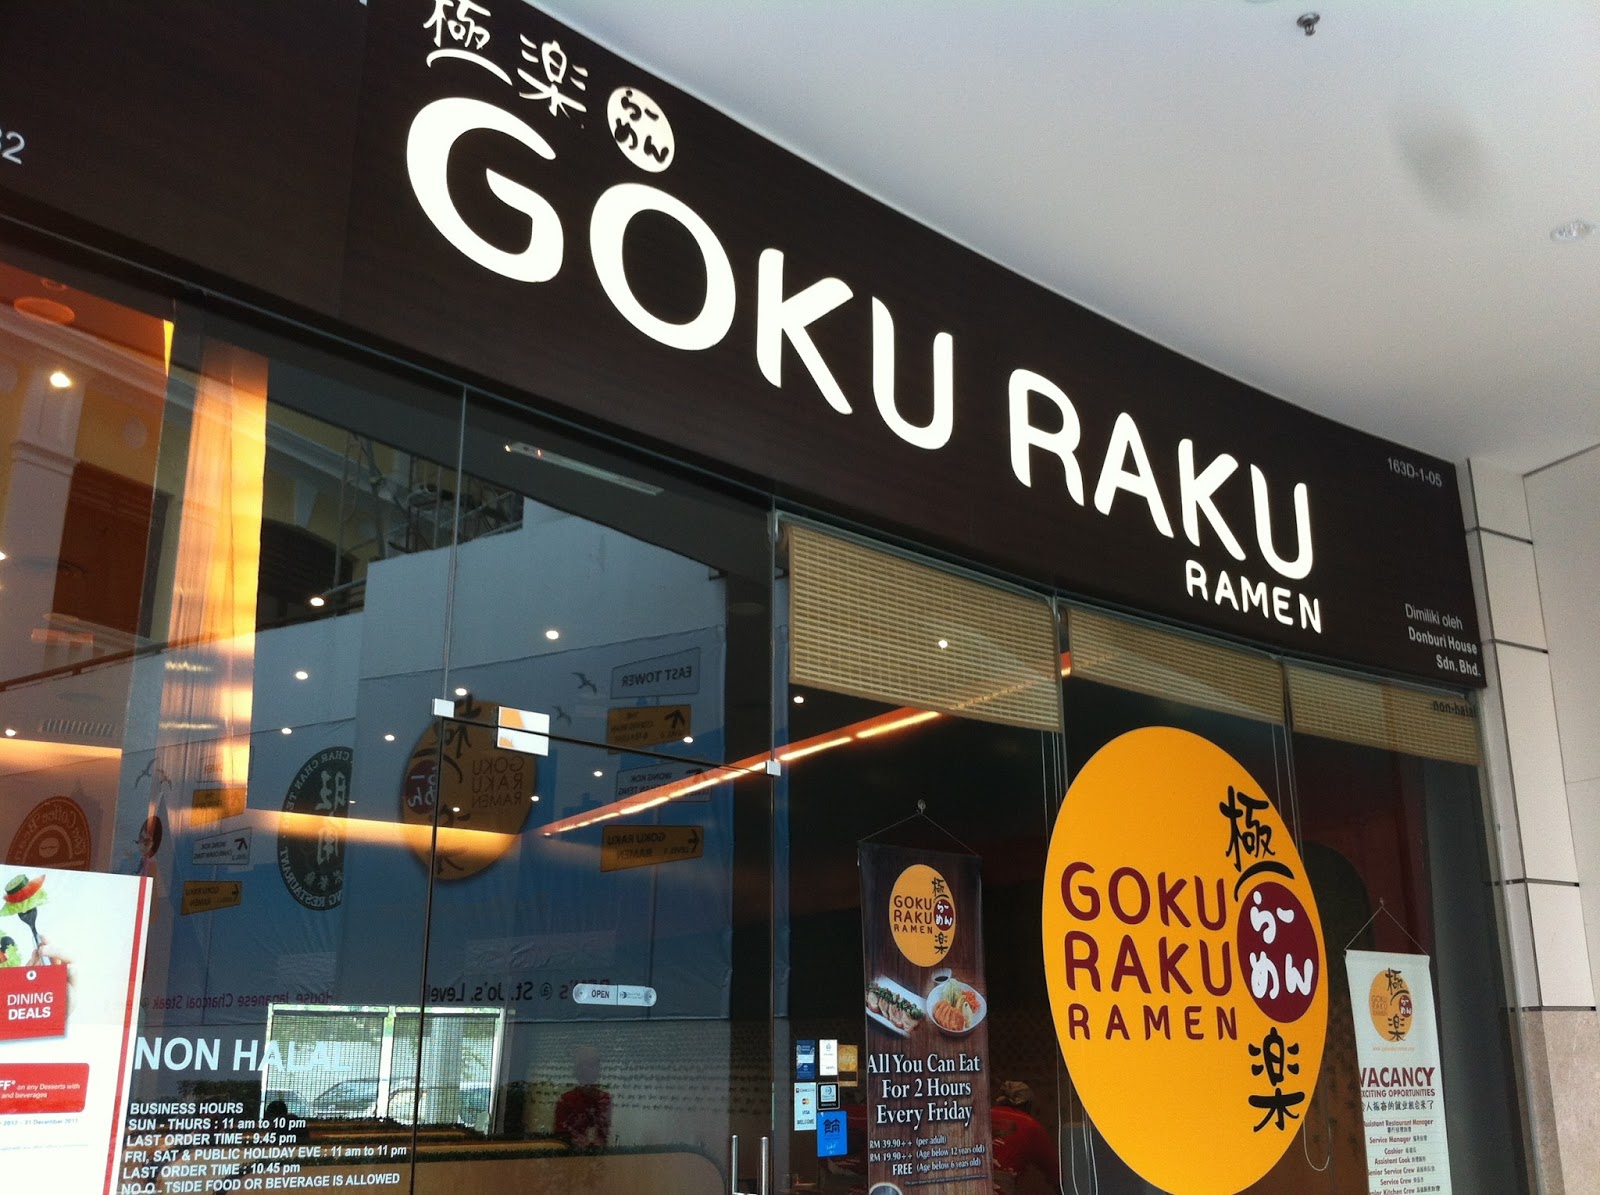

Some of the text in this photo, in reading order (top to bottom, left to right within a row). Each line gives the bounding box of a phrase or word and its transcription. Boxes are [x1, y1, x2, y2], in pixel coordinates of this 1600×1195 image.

[0, 127, 26, 165] 2
[406, 96, 1313, 579] GOKU RAKU
[1387, 457, 1443, 488] 163D-1-05
[1186, 559, 1323, 634] RAMEN
[1405, 603, 1464, 631] Dimiliki oleh
[1408, 626, 1478, 655] Donburi House
[1436, 654, 1482, 677] Sdn. Bhd.
[894, 895, 932, 910] GOKU
[1060, 861, 1227, 931] GOKU
[894, 910, 932, 924] RAKU
[894, 924, 933, 934] RAMEN
[1064, 930, 1232, 997] RAKU
[7, 992, 54, 1006] DINING
[591, 989, 610, 999] OPEN
[8, 1006, 51, 1020] DEALS
[1069, 1003, 1238, 1041] RAMEN
[134, 1036, 350, 1071] NON HALAL
[867, 1053, 980, 1074] All You Can Eat
[882, 1077, 972, 1098] For 2 Hours
[1360, 1066, 1435, 1088] VACANCY
[1360, 1088, 1435, 1098] XCITING OPPORTUNITIES
[130, 1102, 244, 1115] BUSINESS HOURS
[876, 1100, 972, 1130] Every Friday
[128, 1118, 157, 1131] SUN
[167, 1118, 211, 1130] THURS
[222, 1118, 234, 1129] 11
[237, 1120, 255, 1129] am
[258, 1119, 270, 1129] to
[272, 1118, 286, 1128] 10
[288, 1119, 306, 1131] pm
[126, 1132, 297, 1147] LAST ORDER TIME 9.45 pm
[869, 1140, 880, 1149] RM
[125, 1145, 407, 1165] FRI, SAT & PUBLIC HOLIDAY EVE 11 am to 11 pm
[869, 1153, 880, 1162] RM
[931, 1148, 948, 1157] below
[950, 1147, 957, 1155] 12
[122, 1162, 301, 1180] LAST ORDER TIME 10.45 pm
[892, 1163, 912, 1176] FREE
[931, 1161, 949, 1171] below
[121, 1183, 141, 1195] NO
[205, 1179, 241, 1191] FOOD
[244, 1178, 262, 1190] OR
[266, 1175, 330, 1189] BEVERAGE
[332, 1175, 343, 1187] IS
[345, 1173, 400, 1186] ALLOWED
